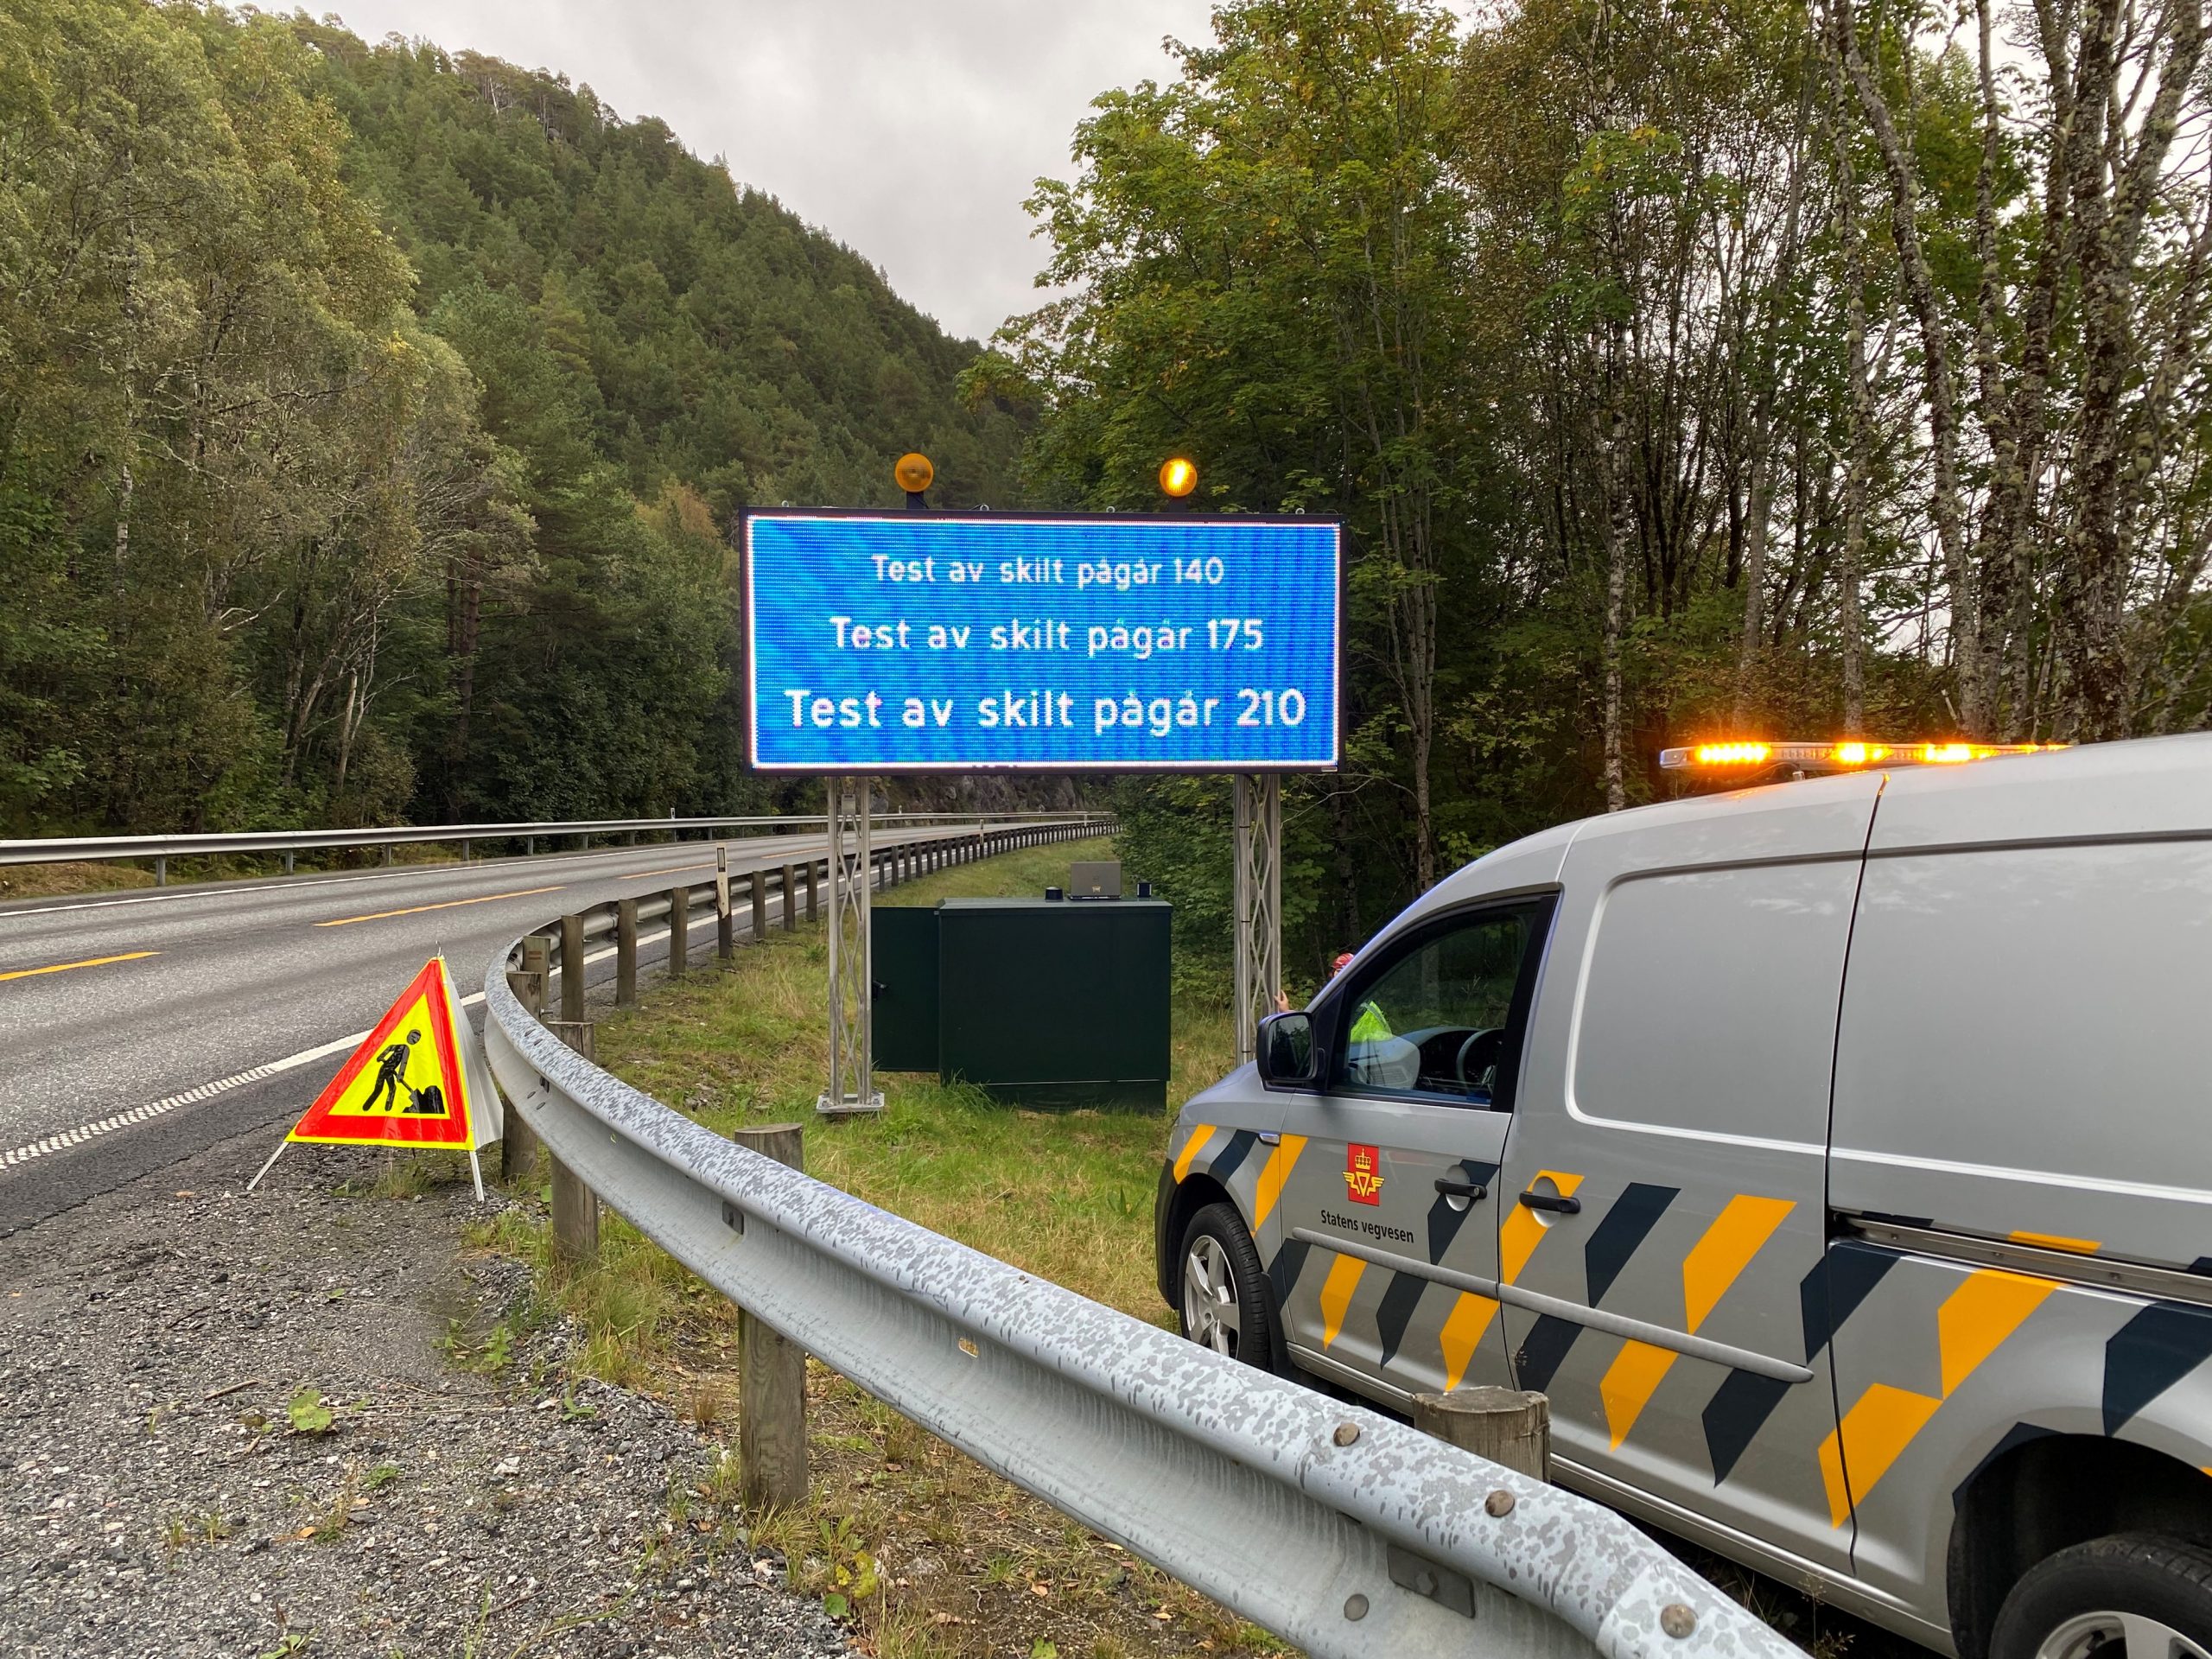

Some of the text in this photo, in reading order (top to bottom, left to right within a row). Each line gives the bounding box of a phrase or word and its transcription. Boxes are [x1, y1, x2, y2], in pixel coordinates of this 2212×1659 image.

[871, 555, 1224, 590] Test av skilt pågår 140
[830, 616, 1263, 659] Test av skilt pågår 175
[785, 688, 1306, 737] Test av skilt pågår 210
[1320, 1210, 1414, 1243] Statens vegvesen
